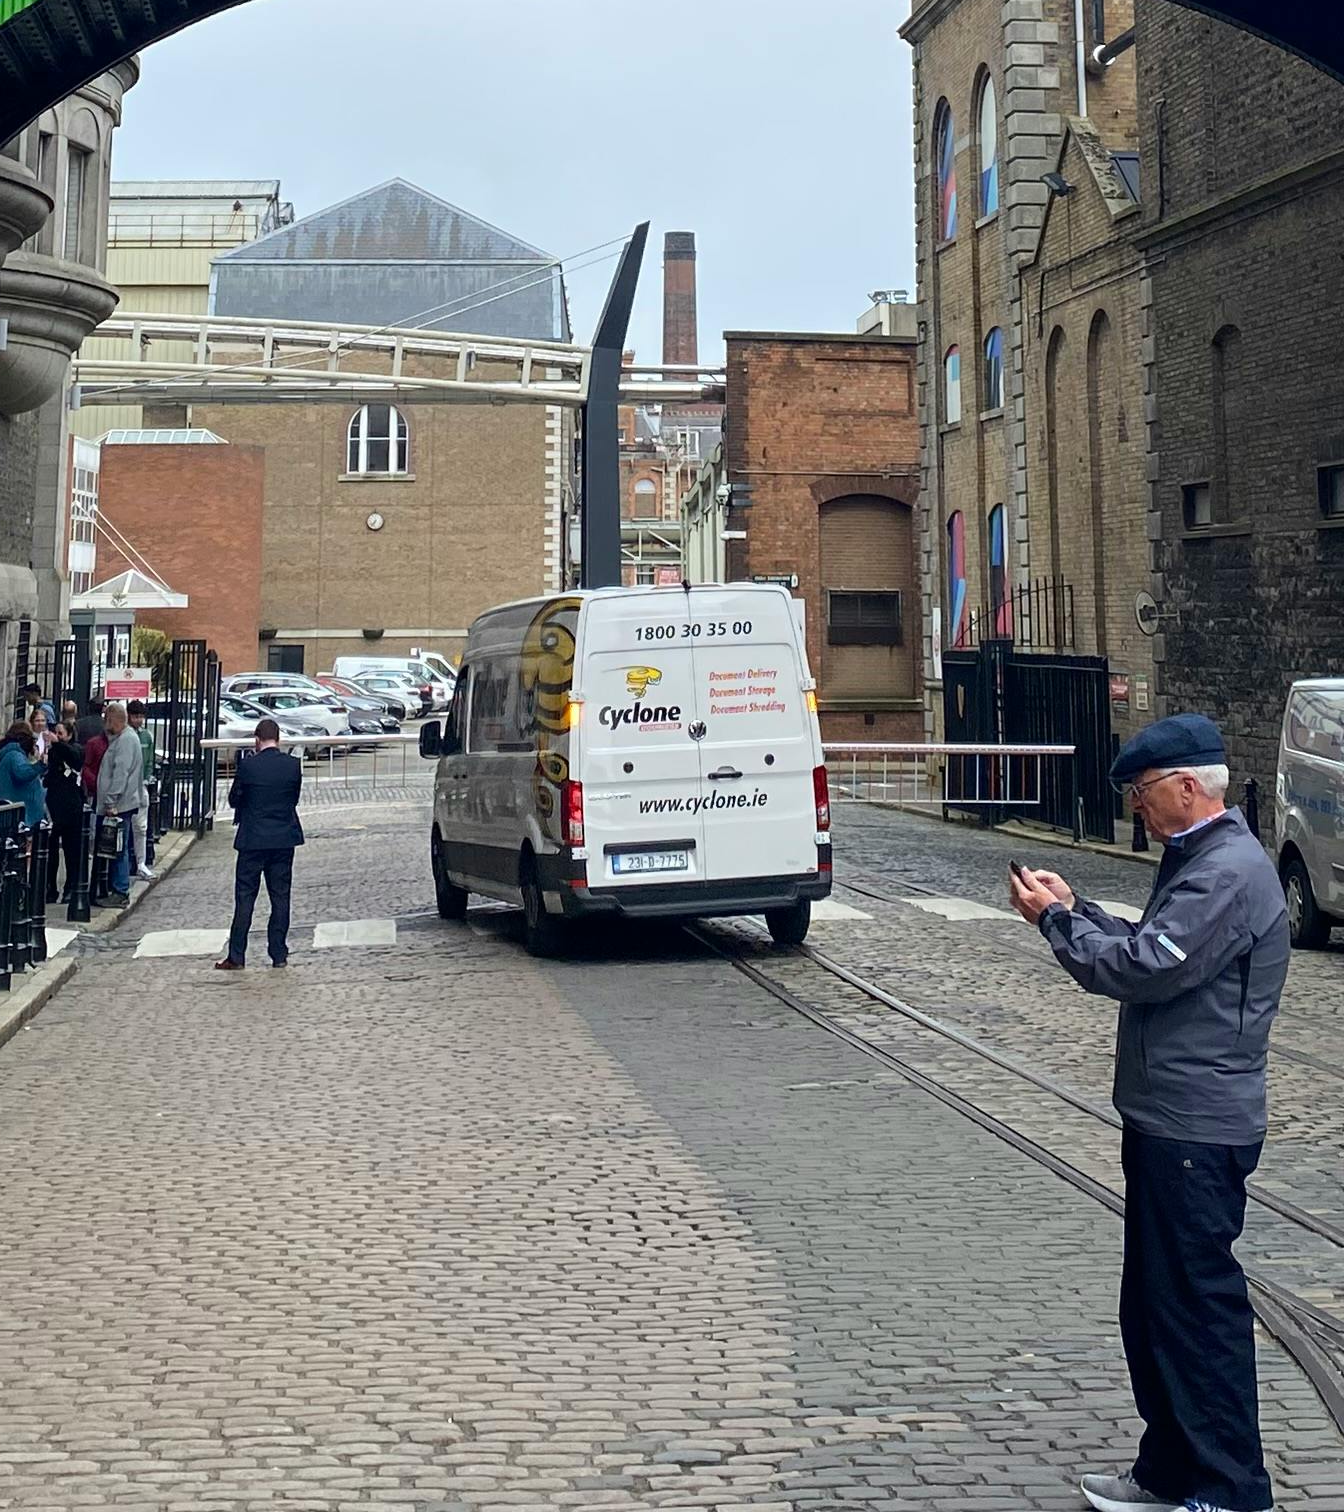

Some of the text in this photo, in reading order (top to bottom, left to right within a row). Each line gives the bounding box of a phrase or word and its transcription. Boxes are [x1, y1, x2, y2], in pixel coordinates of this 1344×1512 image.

[634, 620, 753, 641] 1800 30 35 00
[708, 668, 778, 682] Document Delivery
[709, 685, 776, 699] Document Storage
[598, 701, 682, 731] Cyclone
[710, 700, 786, 715] Document Shredding
[639, 787, 768, 816] www.cyclone.ie
